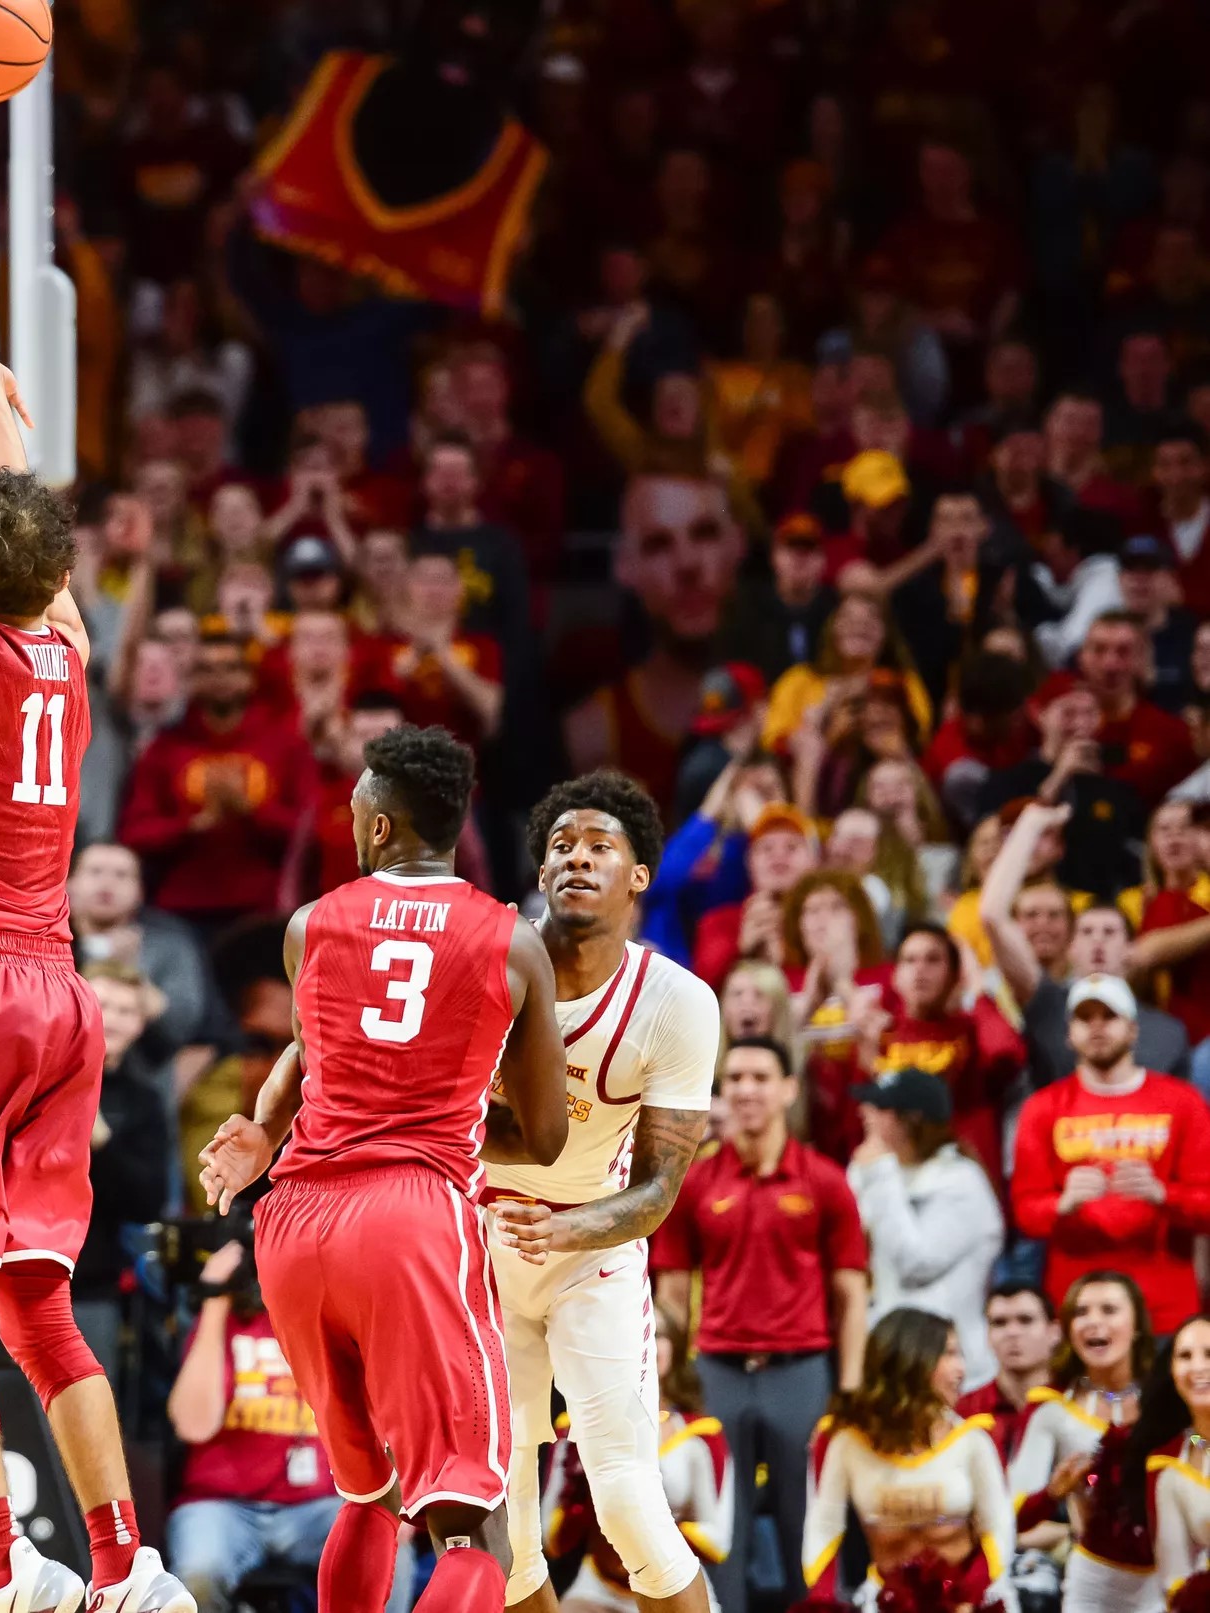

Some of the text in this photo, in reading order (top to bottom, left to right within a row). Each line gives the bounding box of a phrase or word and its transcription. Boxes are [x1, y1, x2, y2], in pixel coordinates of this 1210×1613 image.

[22, 644, 69, 681] YOUNG
[12, 693, 67, 805] 11
[370, 898, 451, 931] LATTIN
[360, 939, 434, 1043] 3
